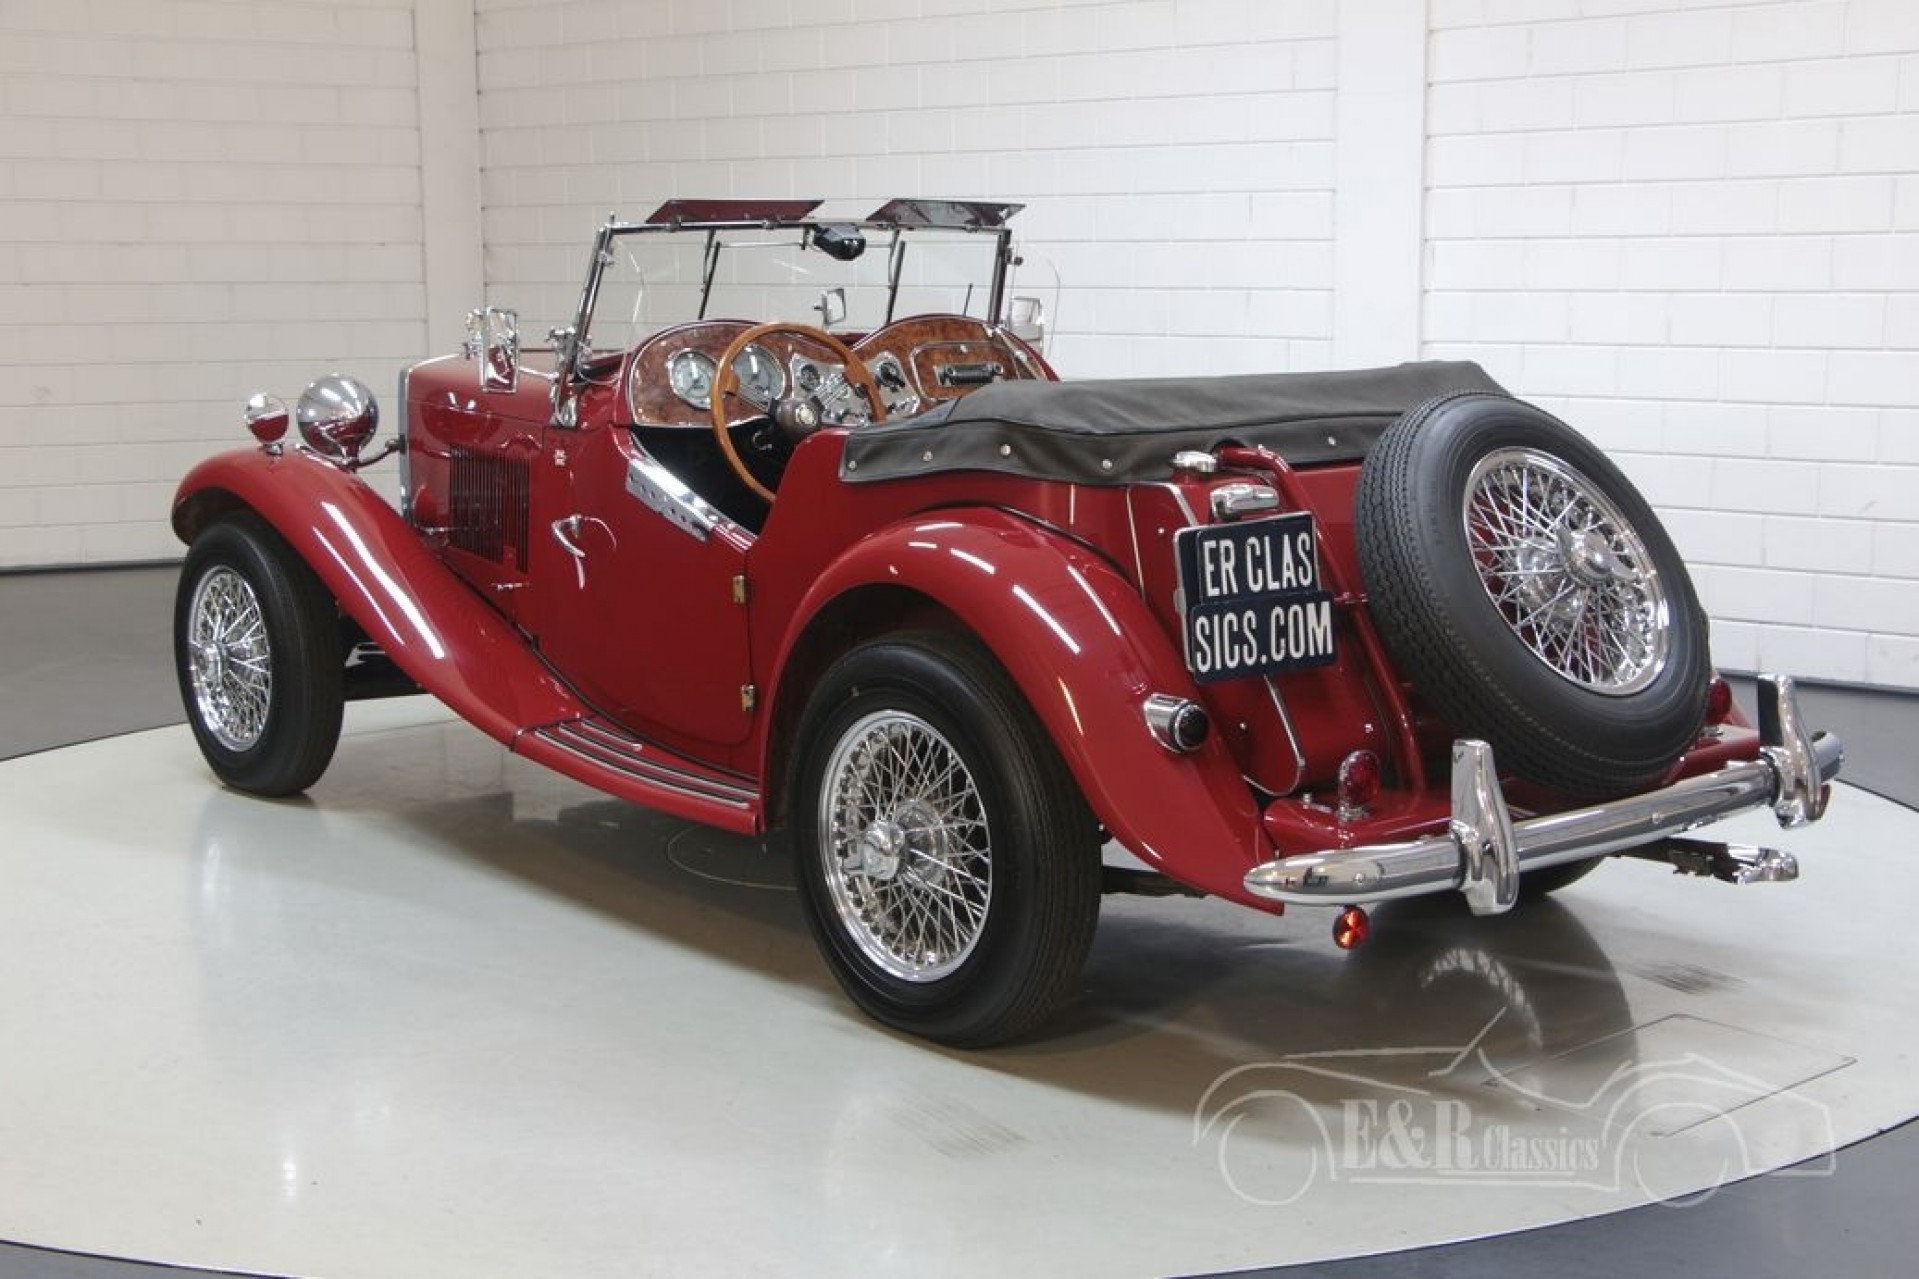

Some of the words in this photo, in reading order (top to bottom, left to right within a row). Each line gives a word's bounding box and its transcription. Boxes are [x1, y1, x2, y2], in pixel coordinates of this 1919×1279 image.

[1203, 540, 1239, 597] ER
[1245, 532, 1313, 592] CLAS
[1195, 601, 1333, 673] SICS.COM
